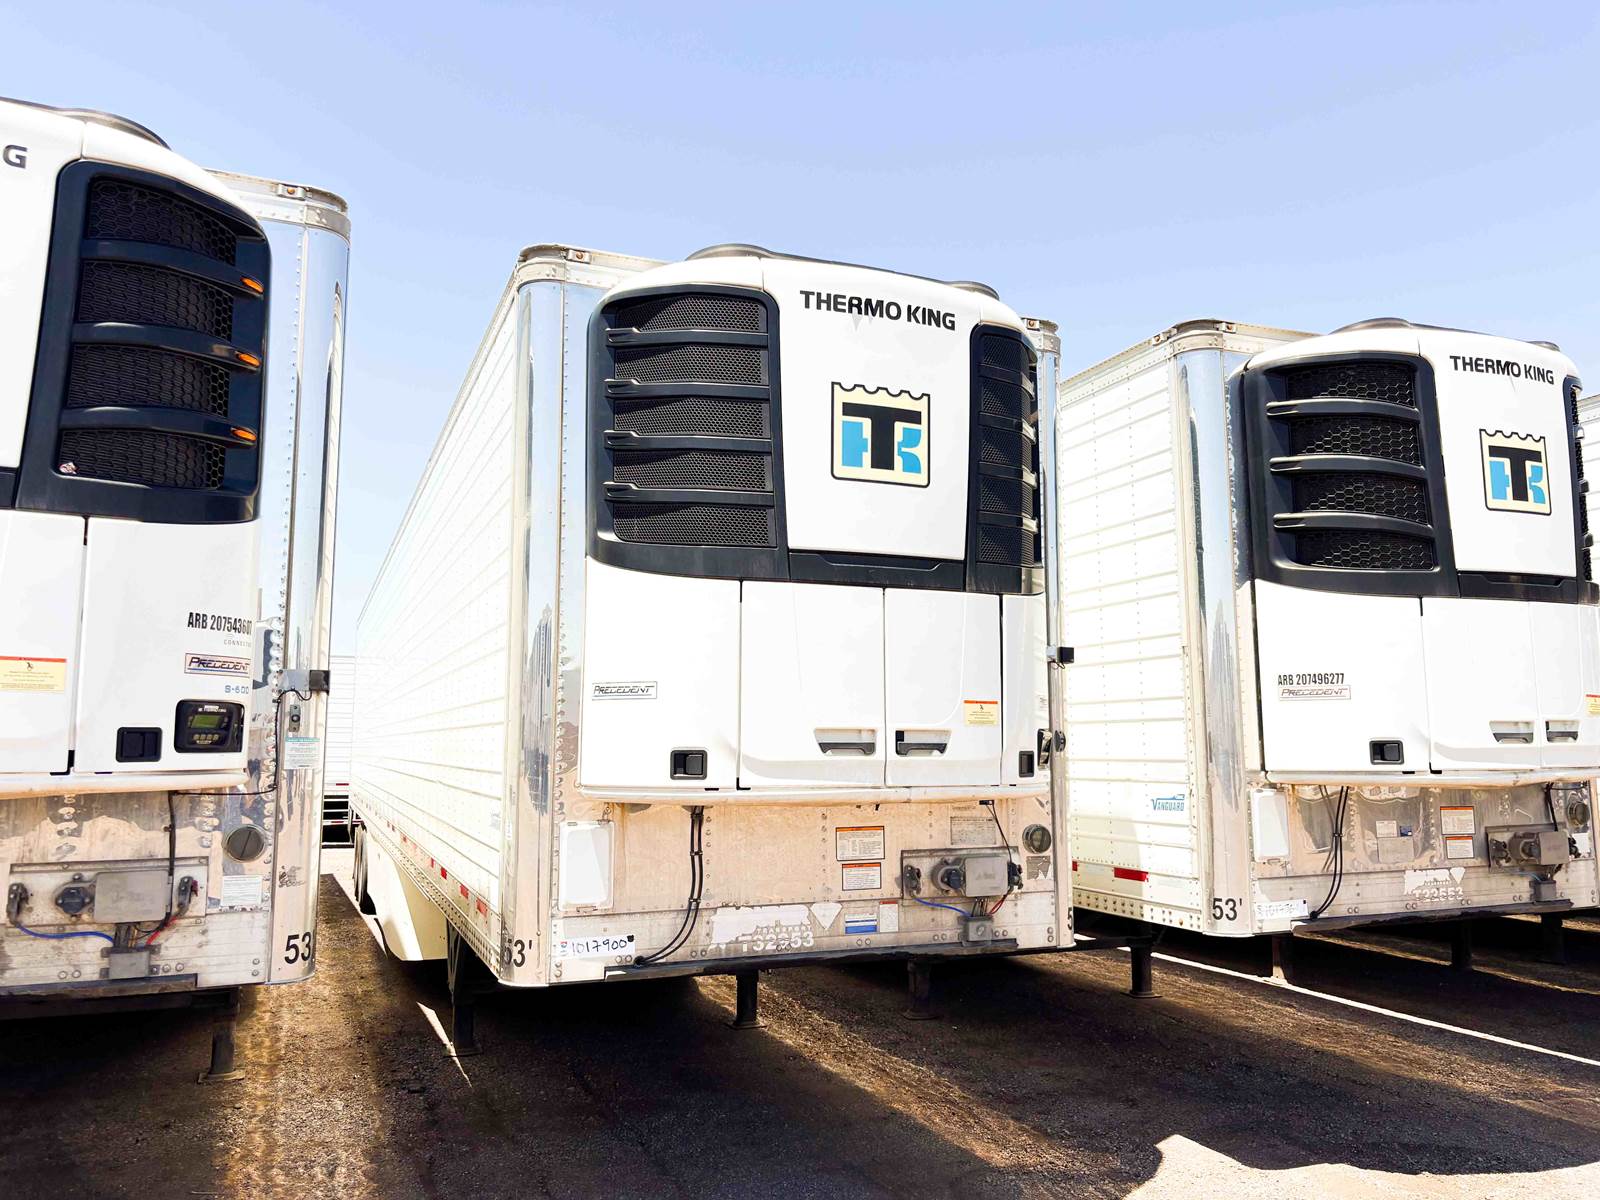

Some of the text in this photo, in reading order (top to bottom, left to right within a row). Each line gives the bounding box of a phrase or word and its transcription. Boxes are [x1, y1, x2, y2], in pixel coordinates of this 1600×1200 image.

[800, 290, 956, 331] THERMO KING
[1450, 355, 1555, 385] THERMO KING
[187, 612, 208, 630] ARB
[188, 656, 250, 671] PRECEDENT
[1277, 672, 1345, 686] ARB 207496277
[593, 685, 655, 695] PRECEDENT
[1281, 688, 1349, 697] PRECEDENT
[1150, 797, 1185, 812] VANGUARD
[1212, 897, 1243, 922] 53'
